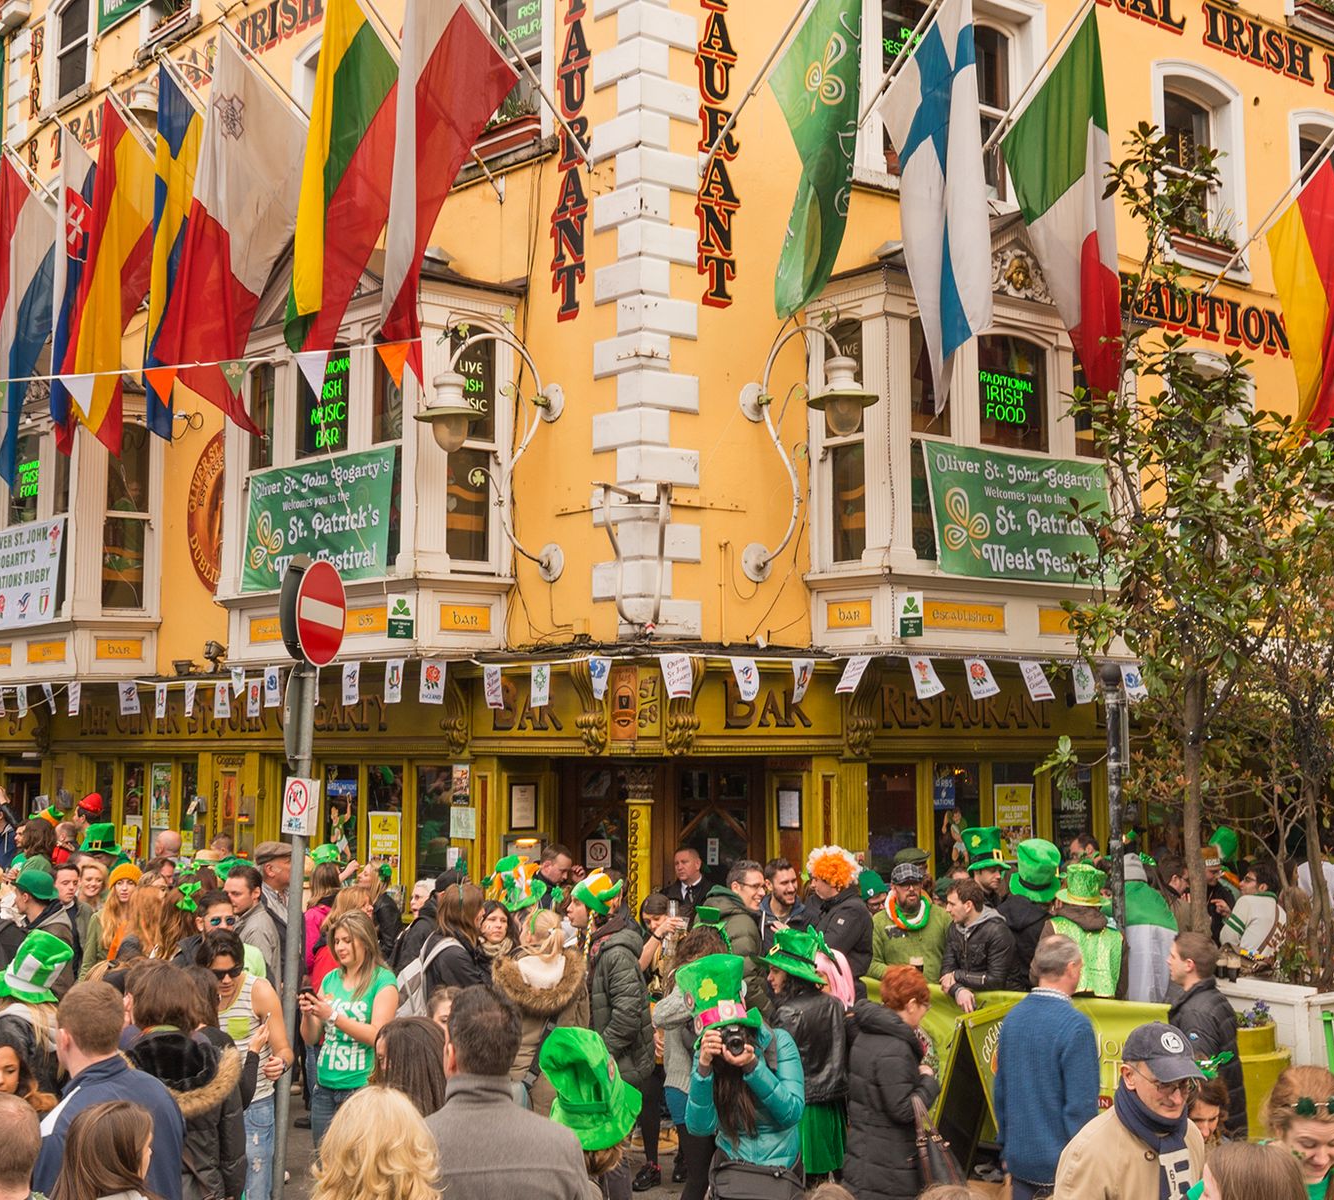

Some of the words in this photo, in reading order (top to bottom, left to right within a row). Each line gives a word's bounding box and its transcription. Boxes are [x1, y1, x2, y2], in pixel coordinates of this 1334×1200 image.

[1202, 2, 1315, 86] IRISH
[28, 26, 44, 120] BAR
[459, 360, 484, 375] LIVE
[978, 370, 1034, 394] TRADITIONAL
[985, 385, 1024, 407] IRISH
[985, 405, 1027, 425] FOOD
[315, 427, 340, 449] BAR
[255, 477, 281, 501] Oliver
[301, 469, 328, 494] John
[331, 459, 390, 487] Gogarty's
[935, 453, 981, 475] Oliver
[984, 459, 1005, 480] St.
[1007, 463, 1039, 485] John
[1042, 468, 1103, 491] Gogarty's
[282, 498, 314, 512] Welcomes
[314, 495, 329, 509] you
[329, 494, 337, 505] to
[983, 486, 1024, 502] Welcomes
[1025, 492, 1042, 505] you
[1043, 493, 1053, 504] to
[1054, 494, 1067, 506] the
[312, 505, 380, 541] Patrick's
[995, 505, 1021, 536] St.
[26, 527, 49, 545] JOHN
[982, 542, 1035, 574] Week
[24, 567, 51, 585] RUGBY
[638, 675, 660, 698] 57
[491, 676, 564, 732] BAR
[638, 703, 660, 729] 58
[880, 684, 1056, 730] RESTAURANT
[79, 703, 110, 737] THE
[1061, 800, 1087, 812] Music
